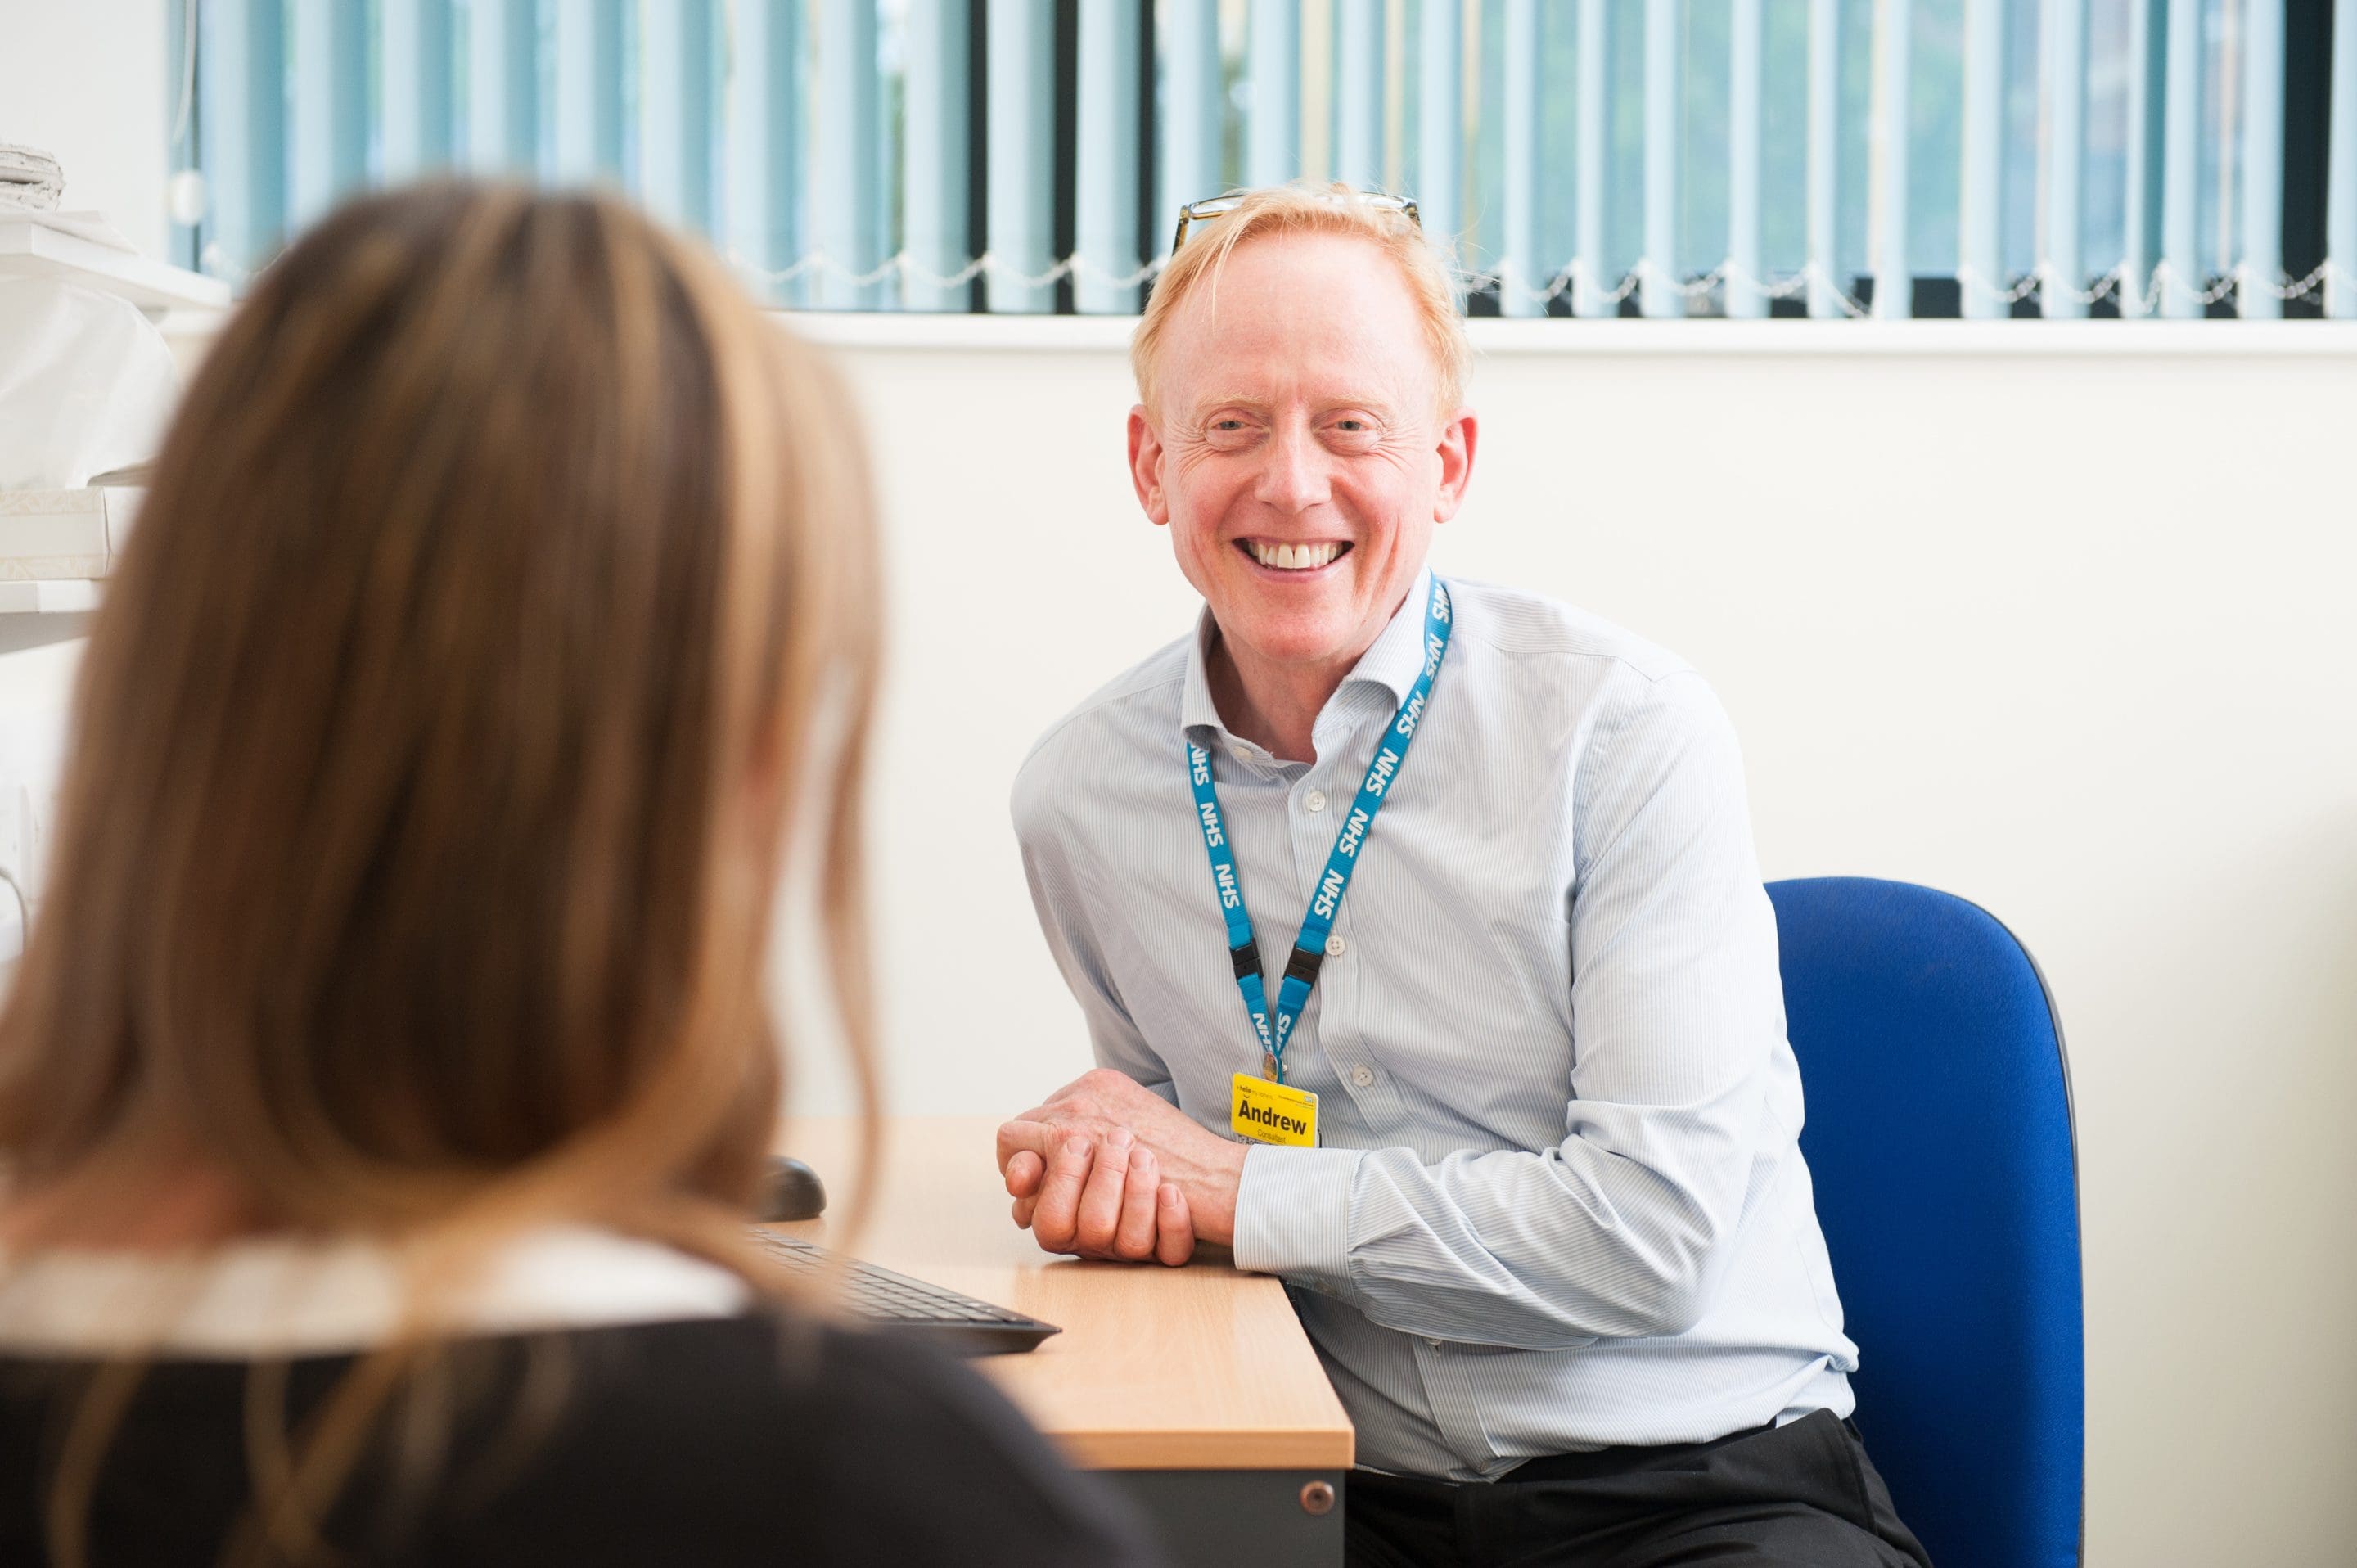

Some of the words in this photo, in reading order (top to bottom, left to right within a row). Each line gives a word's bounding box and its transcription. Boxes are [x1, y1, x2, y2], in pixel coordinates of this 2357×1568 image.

[1432, 582, 1450, 624] NHS
[1426, 632, 1444, 682] NHS
[1396, 690, 1426, 739] NHS
[1366, 747, 1399, 796] NHS
[1200, 802, 1224, 848] NHS
[1339, 808, 1369, 858] NHS
[1215, 863, 1240, 909] NHS
[1314, 869, 1344, 920] NHS
[1238, 1099, 1307, 1135] Andrew
[1257, 1129, 1286, 1143] Consultant
